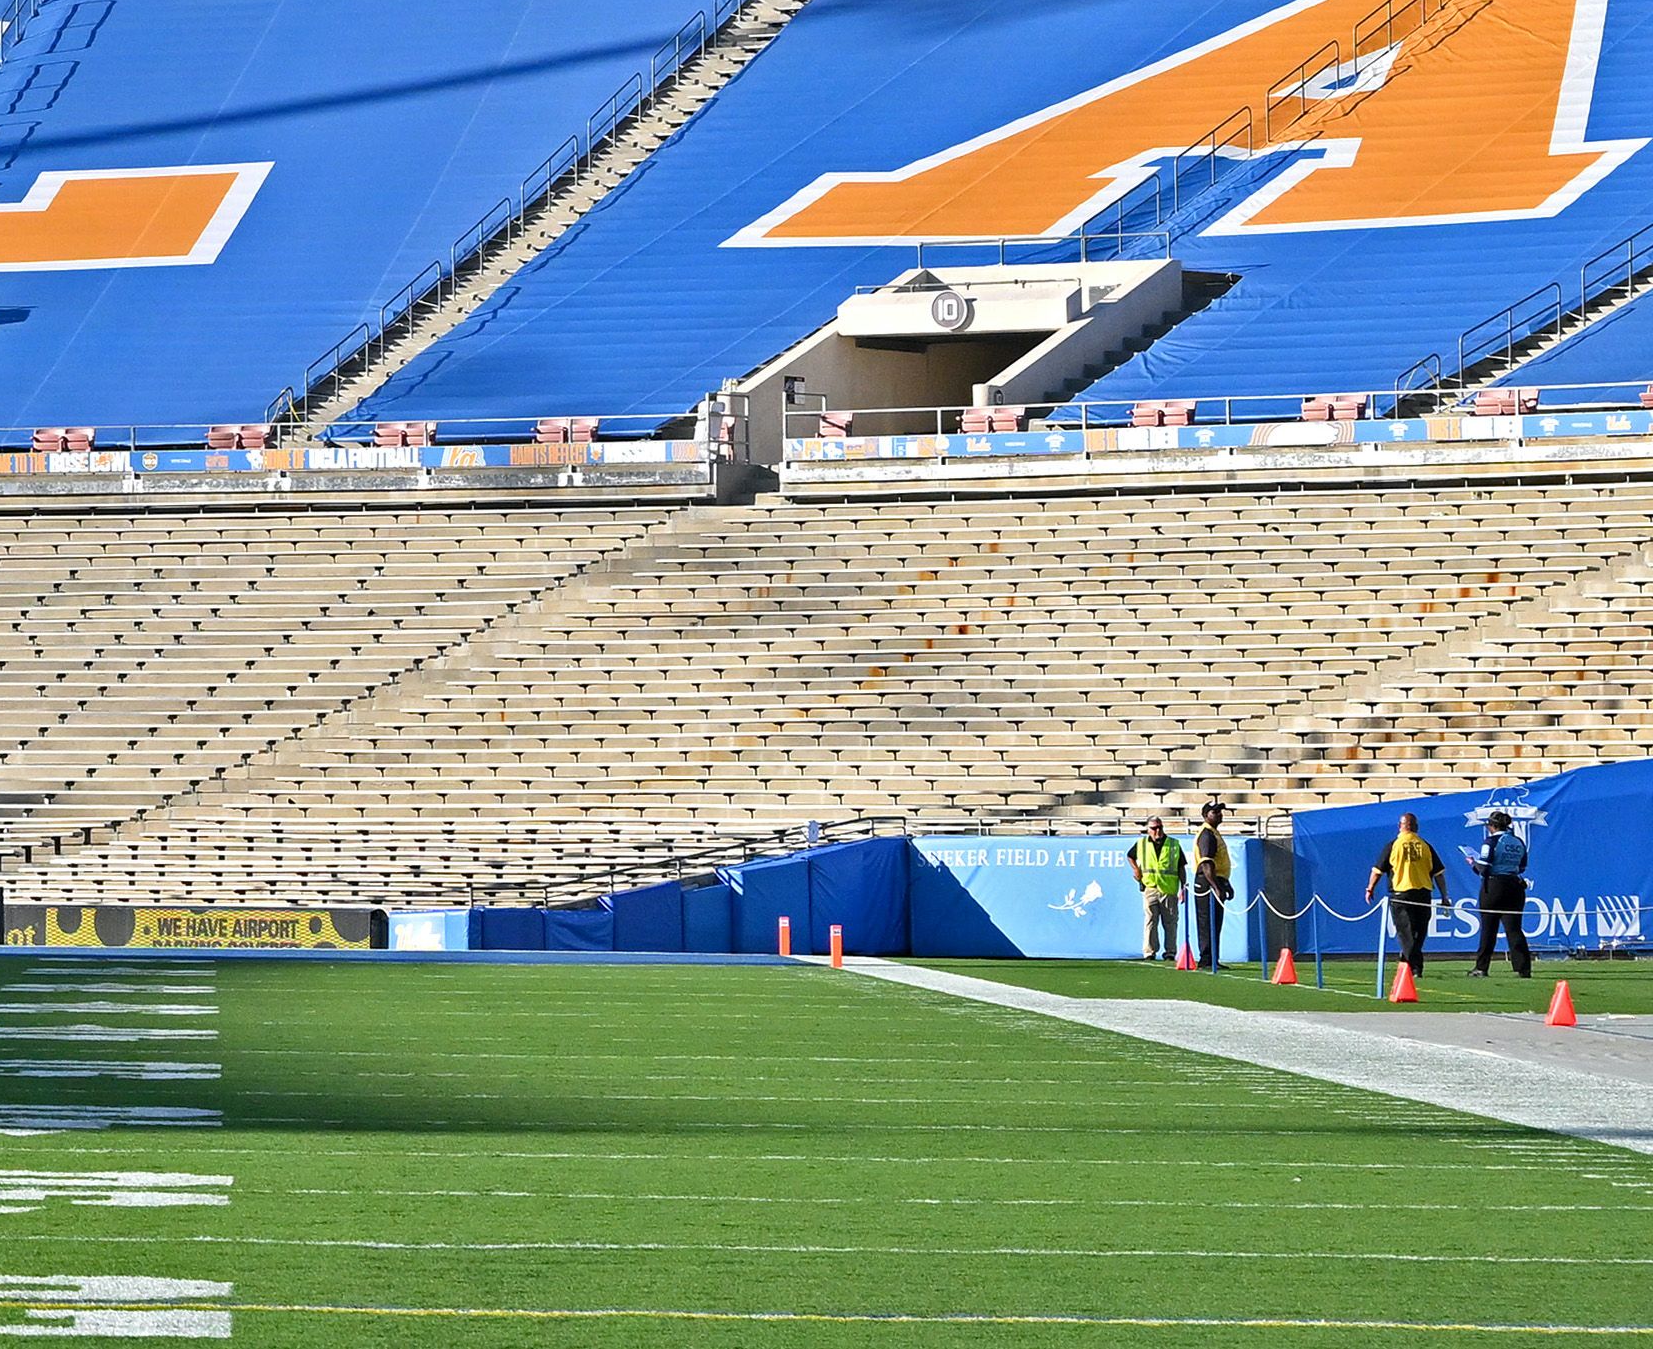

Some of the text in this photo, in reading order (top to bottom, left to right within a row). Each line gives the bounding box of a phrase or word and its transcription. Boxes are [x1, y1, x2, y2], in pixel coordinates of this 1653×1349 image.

[938, 299, 958, 321] 10
[50, 452, 88, 473] ROSE
[997, 849, 1049, 867] FIELD
[1055, 850, 1078, 868] AT
[1087, 850, 1125, 868] THE
[156, 917, 300, 938] WE HAVE AIRPORT
